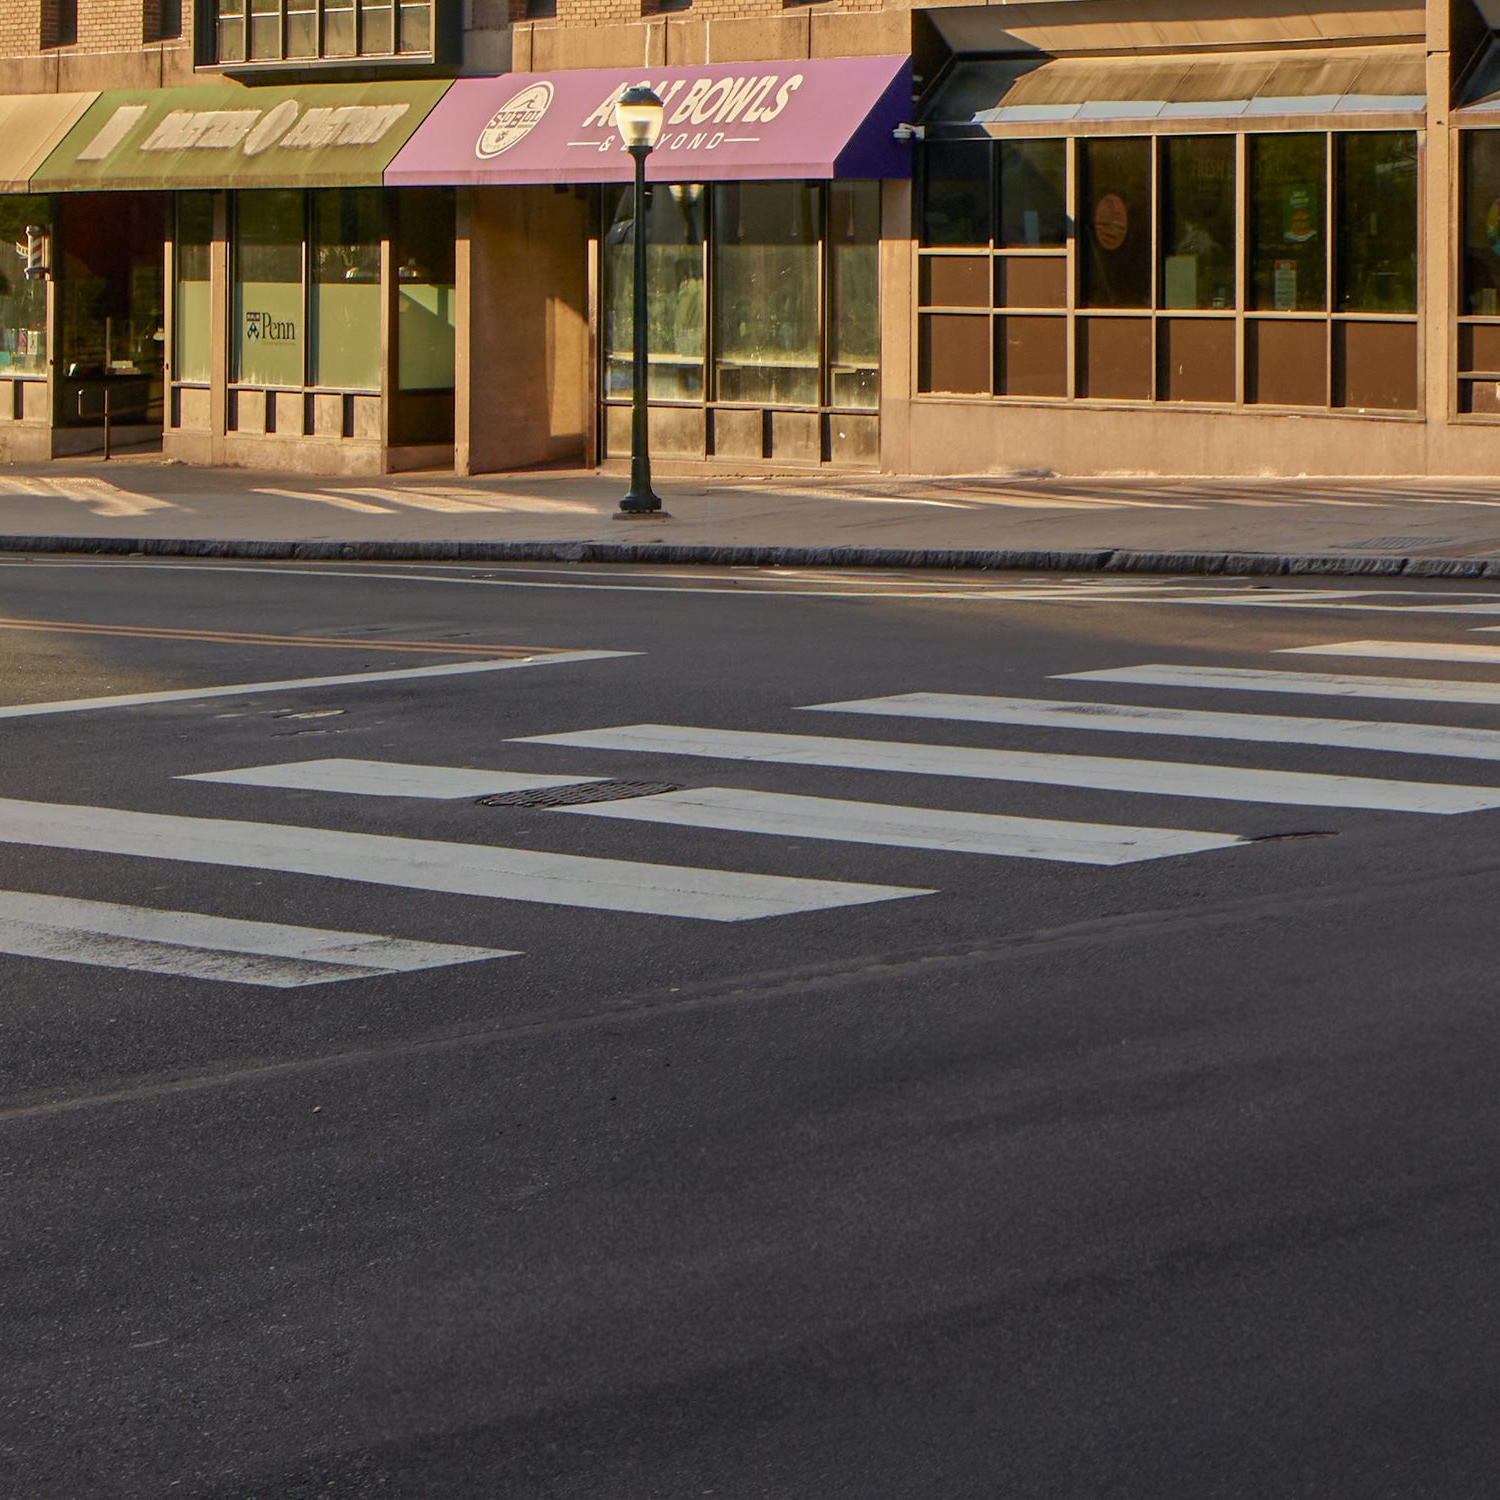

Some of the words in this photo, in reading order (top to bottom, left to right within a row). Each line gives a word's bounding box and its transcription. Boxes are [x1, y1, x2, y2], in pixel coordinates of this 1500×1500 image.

[582, 80, 687, 127] AI
[668, 74, 804, 125] BOWLS
[598, 135, 616, 152] &
[620, 132, 725, 152] YOND
[261, 311, 296, 340] Penn
